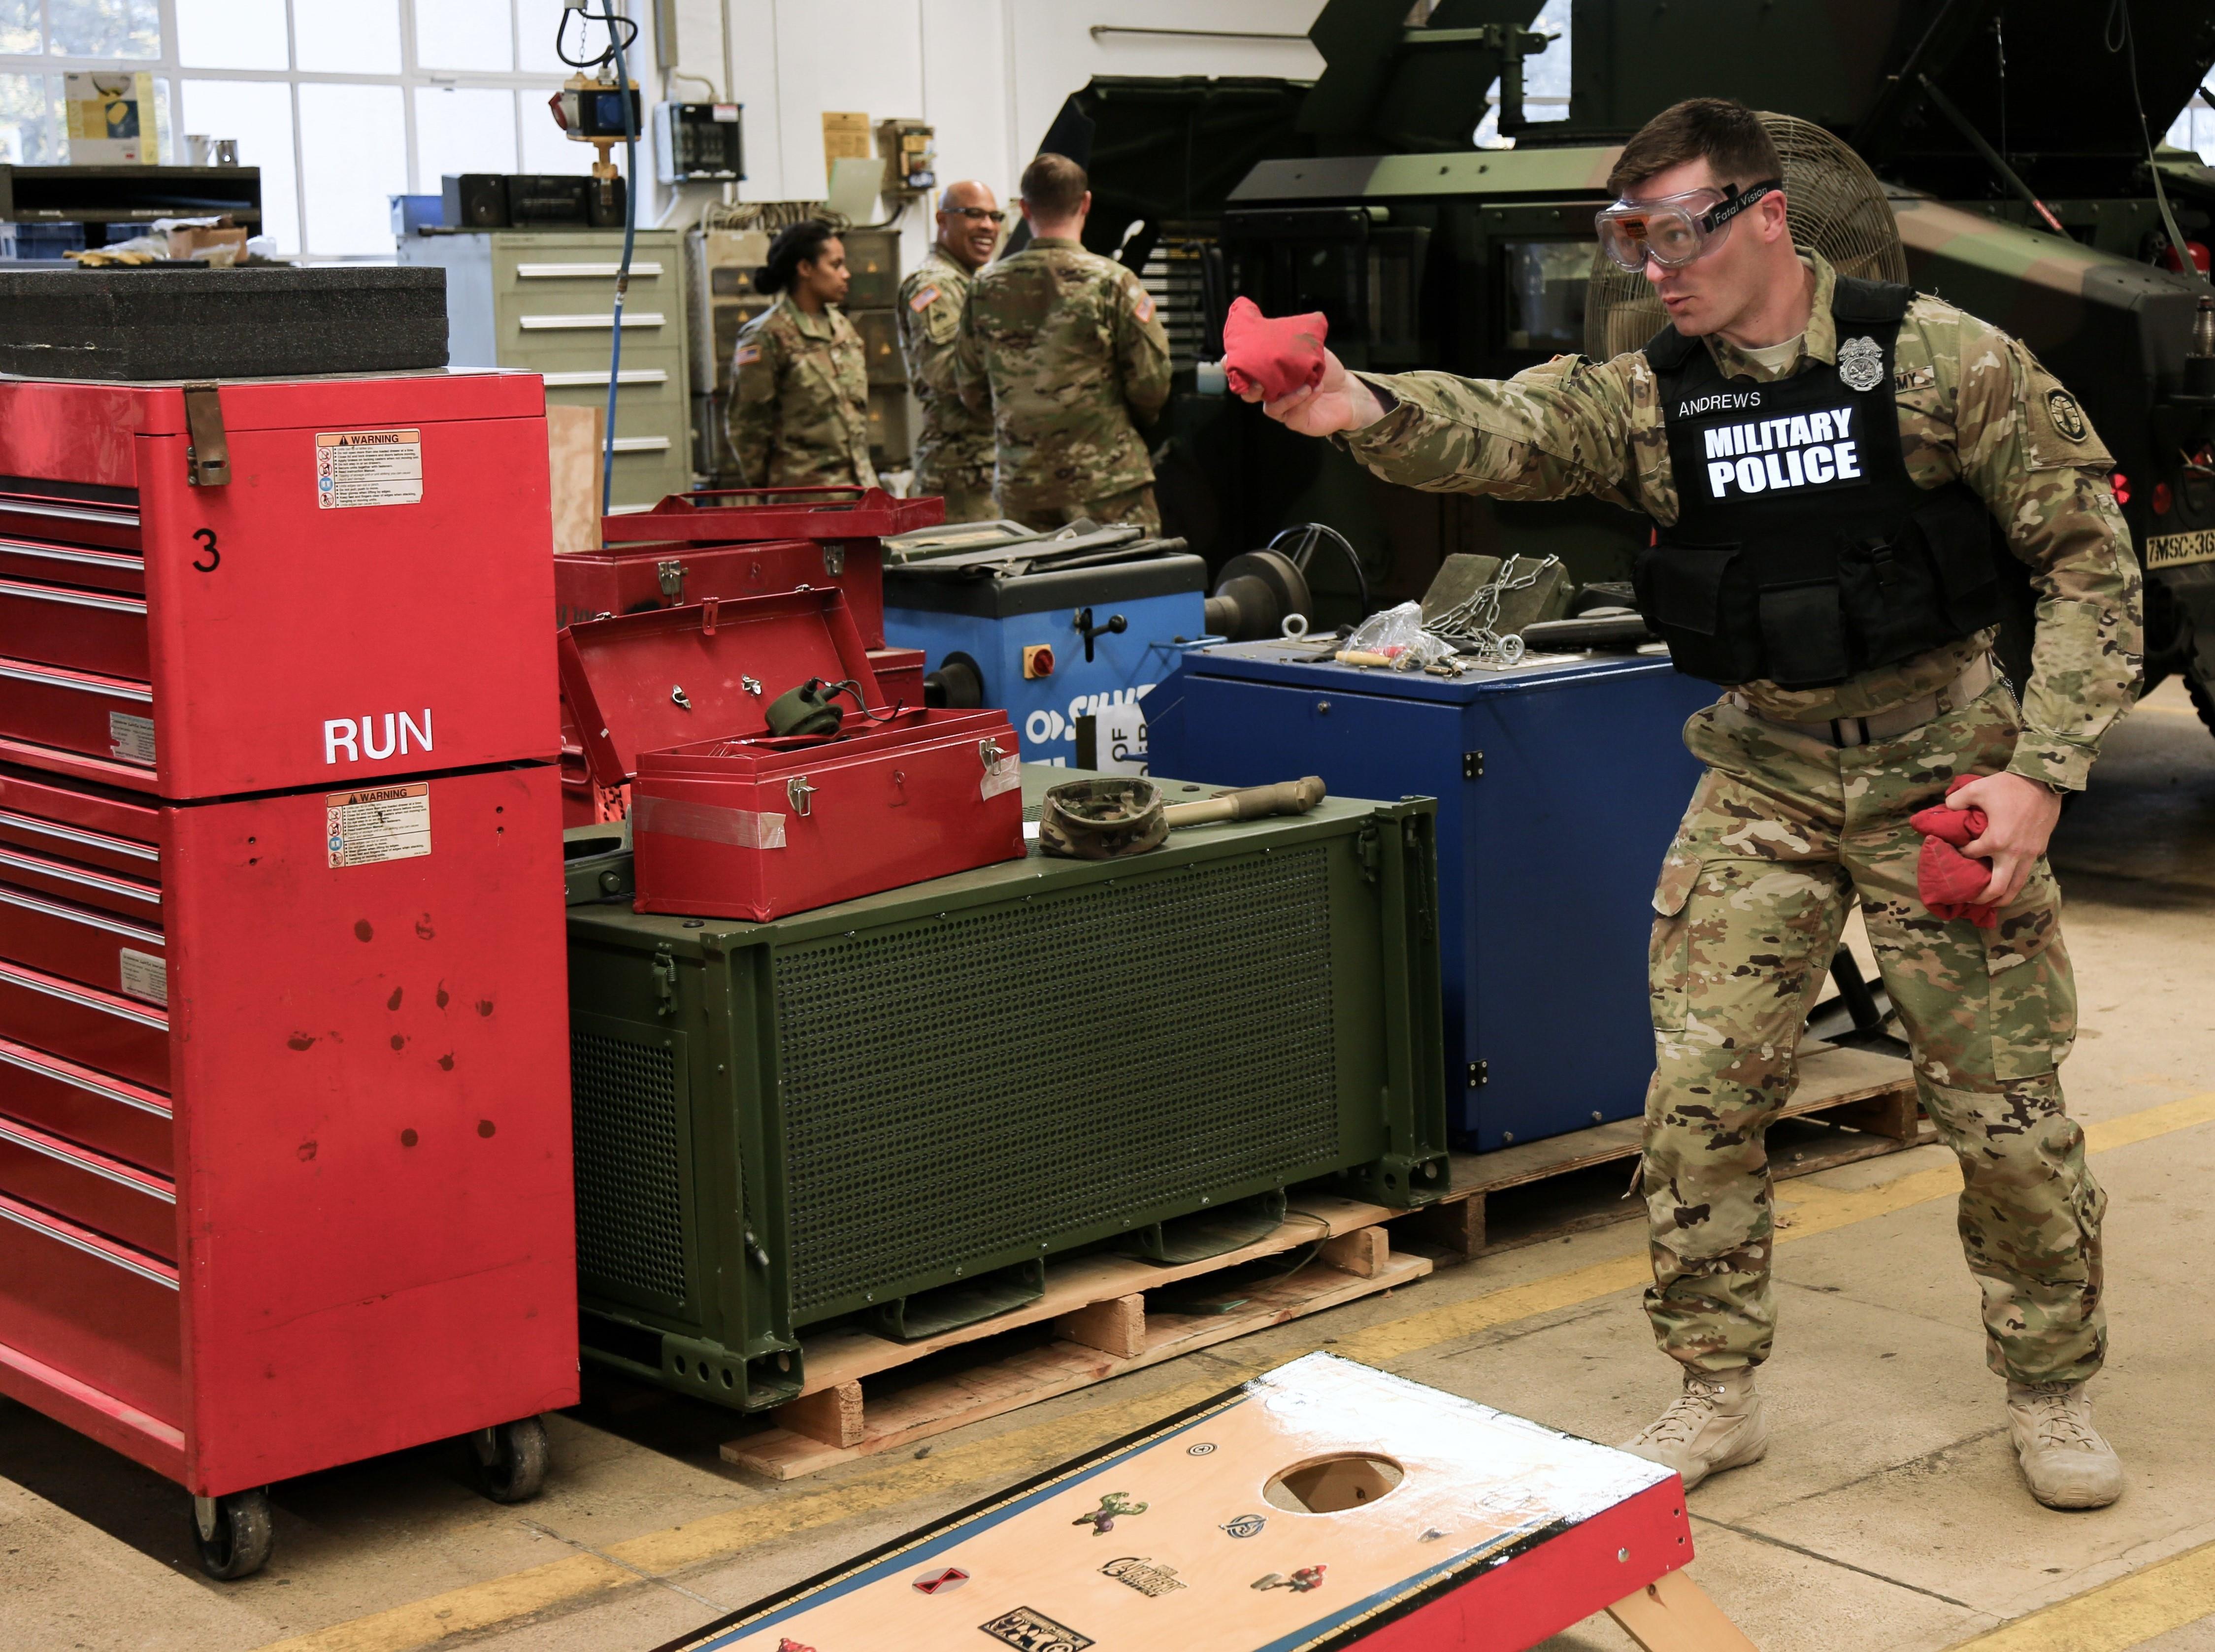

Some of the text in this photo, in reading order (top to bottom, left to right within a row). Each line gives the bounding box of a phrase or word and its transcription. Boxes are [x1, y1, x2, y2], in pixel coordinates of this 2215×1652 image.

[1715, 187, 1767, 224] Fatal Vision
[1895, 372, 1916, 390] MY
[1679, 392, 1761, 417] ANDREWS
[351, 434, 399, 444] WARNING
[1704, 408, 1852, 459] MILITARY
[1707, 441, 1861, 497] POLICE
[193, 529, 220, 572] 3
[325, 708, 433, 764] RUN
[1112, 728, 1128, 762] OF
[360, 789, 407, 802] WARNING
